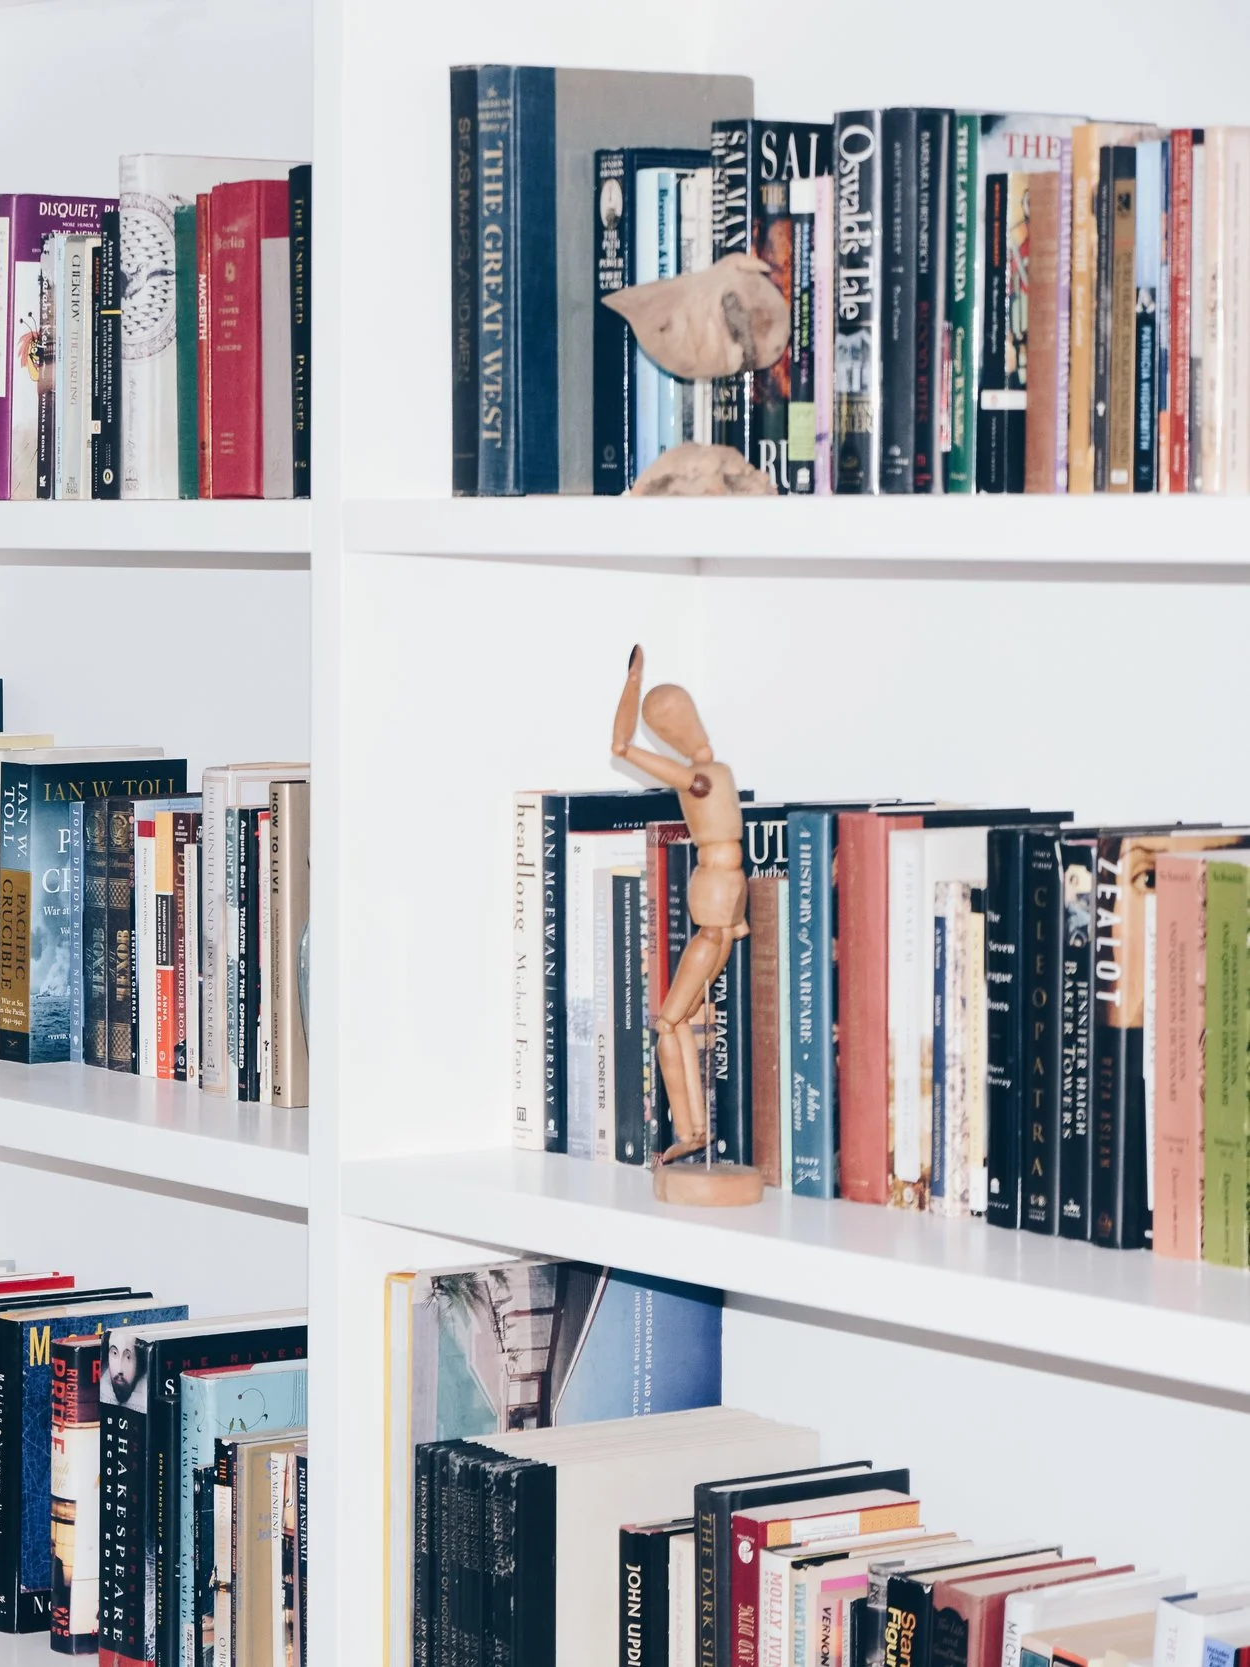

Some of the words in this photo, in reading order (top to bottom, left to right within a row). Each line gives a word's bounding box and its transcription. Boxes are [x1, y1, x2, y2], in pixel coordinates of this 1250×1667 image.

[1003, 132, 1060, 159] THE
[482, 142, 503, 212] THE
[711, 133, 727, 246] RUSHDIE
[726, 130, 747, 248] SALMAN
[839, 124, 876, 256] Oswald's
[39, 202, 99, 219] DISQUIET,
[198, 273, 207, 341] MACBETH
[482, 224, 503, 334] GREAT
[839, 256, 874, 321] Tale
[482, 346, 503, 448] WEST
[3, 787, 15, 848] TOLL
[17, 782, 28, 827] IAN
[271, 792, 279, 828] HOW
[272, 832, 279, 853] TO
[543, 814, 556, 859] IAN
[72, 855, 80, 914] DIDION
[515, 802, 536, 934] headlong
[799, 846, 811, 925] HISTORY
[1, 878, 14, 990] CRUCIBLE
[15, 893, 27, 981] PACIFIC
[42, 906, 61, 916] War
[72, 923, 80, 960] BLUE
[1096, 857, 1123, 1008] ZEALOT
[72, 969, 80, 1027] NIGHTS
[178, 958, 186, 1000] MURDER
[239, 960, 246, 975] OF
[1063, 960, 1078, 1036] BAKER
[178, 1009, 186, 1047] ROOM
[798, 955, 813, 1046] WARFARE
[1076, 980, 1088, 1070] JENNIFER
[515, 1032, 528, 1090] Frayn
[545, 1000, 554, 1105] SATURDAY
[714, 1015, 730, 1081] HAGEN
[1031, 887, 1047, 1179] CLEOPATRA
[1062, 1045, 1077, 1141] TOWERS
[1075, 1074, 1087, 1137] HAIGH
[644, 1289, 653, 1368] PHOTOGRAPHS
[66, 1368, 79, 1425] RICHARD
[644, 1372, 652, 1395] AND
[105, 1418, 113, 1512] SECOND
[219, 1459, 227, 1480] THE
[441, 1486, 449, 1510] THE
[113, 1418, 128, 1643] SHAKESPEARE
[300, 1499, 308, 1561] BASEBALL
[441, 1514, 449, 1572] MEANINGS
[701, 1514, 713, 1558] THE
[103, 1533, 112, 1636] EDITION
[442, 1576, 449, 1591] OF
[625, 1563, 642, 1618] JOHN
[701, 1570, 714, 1629] DARK
[441, 1595, 449, 1643] MODERN
[627, 1624, 642, 1667] UPDI
[820, 1607, 832, 1667] VERNON
